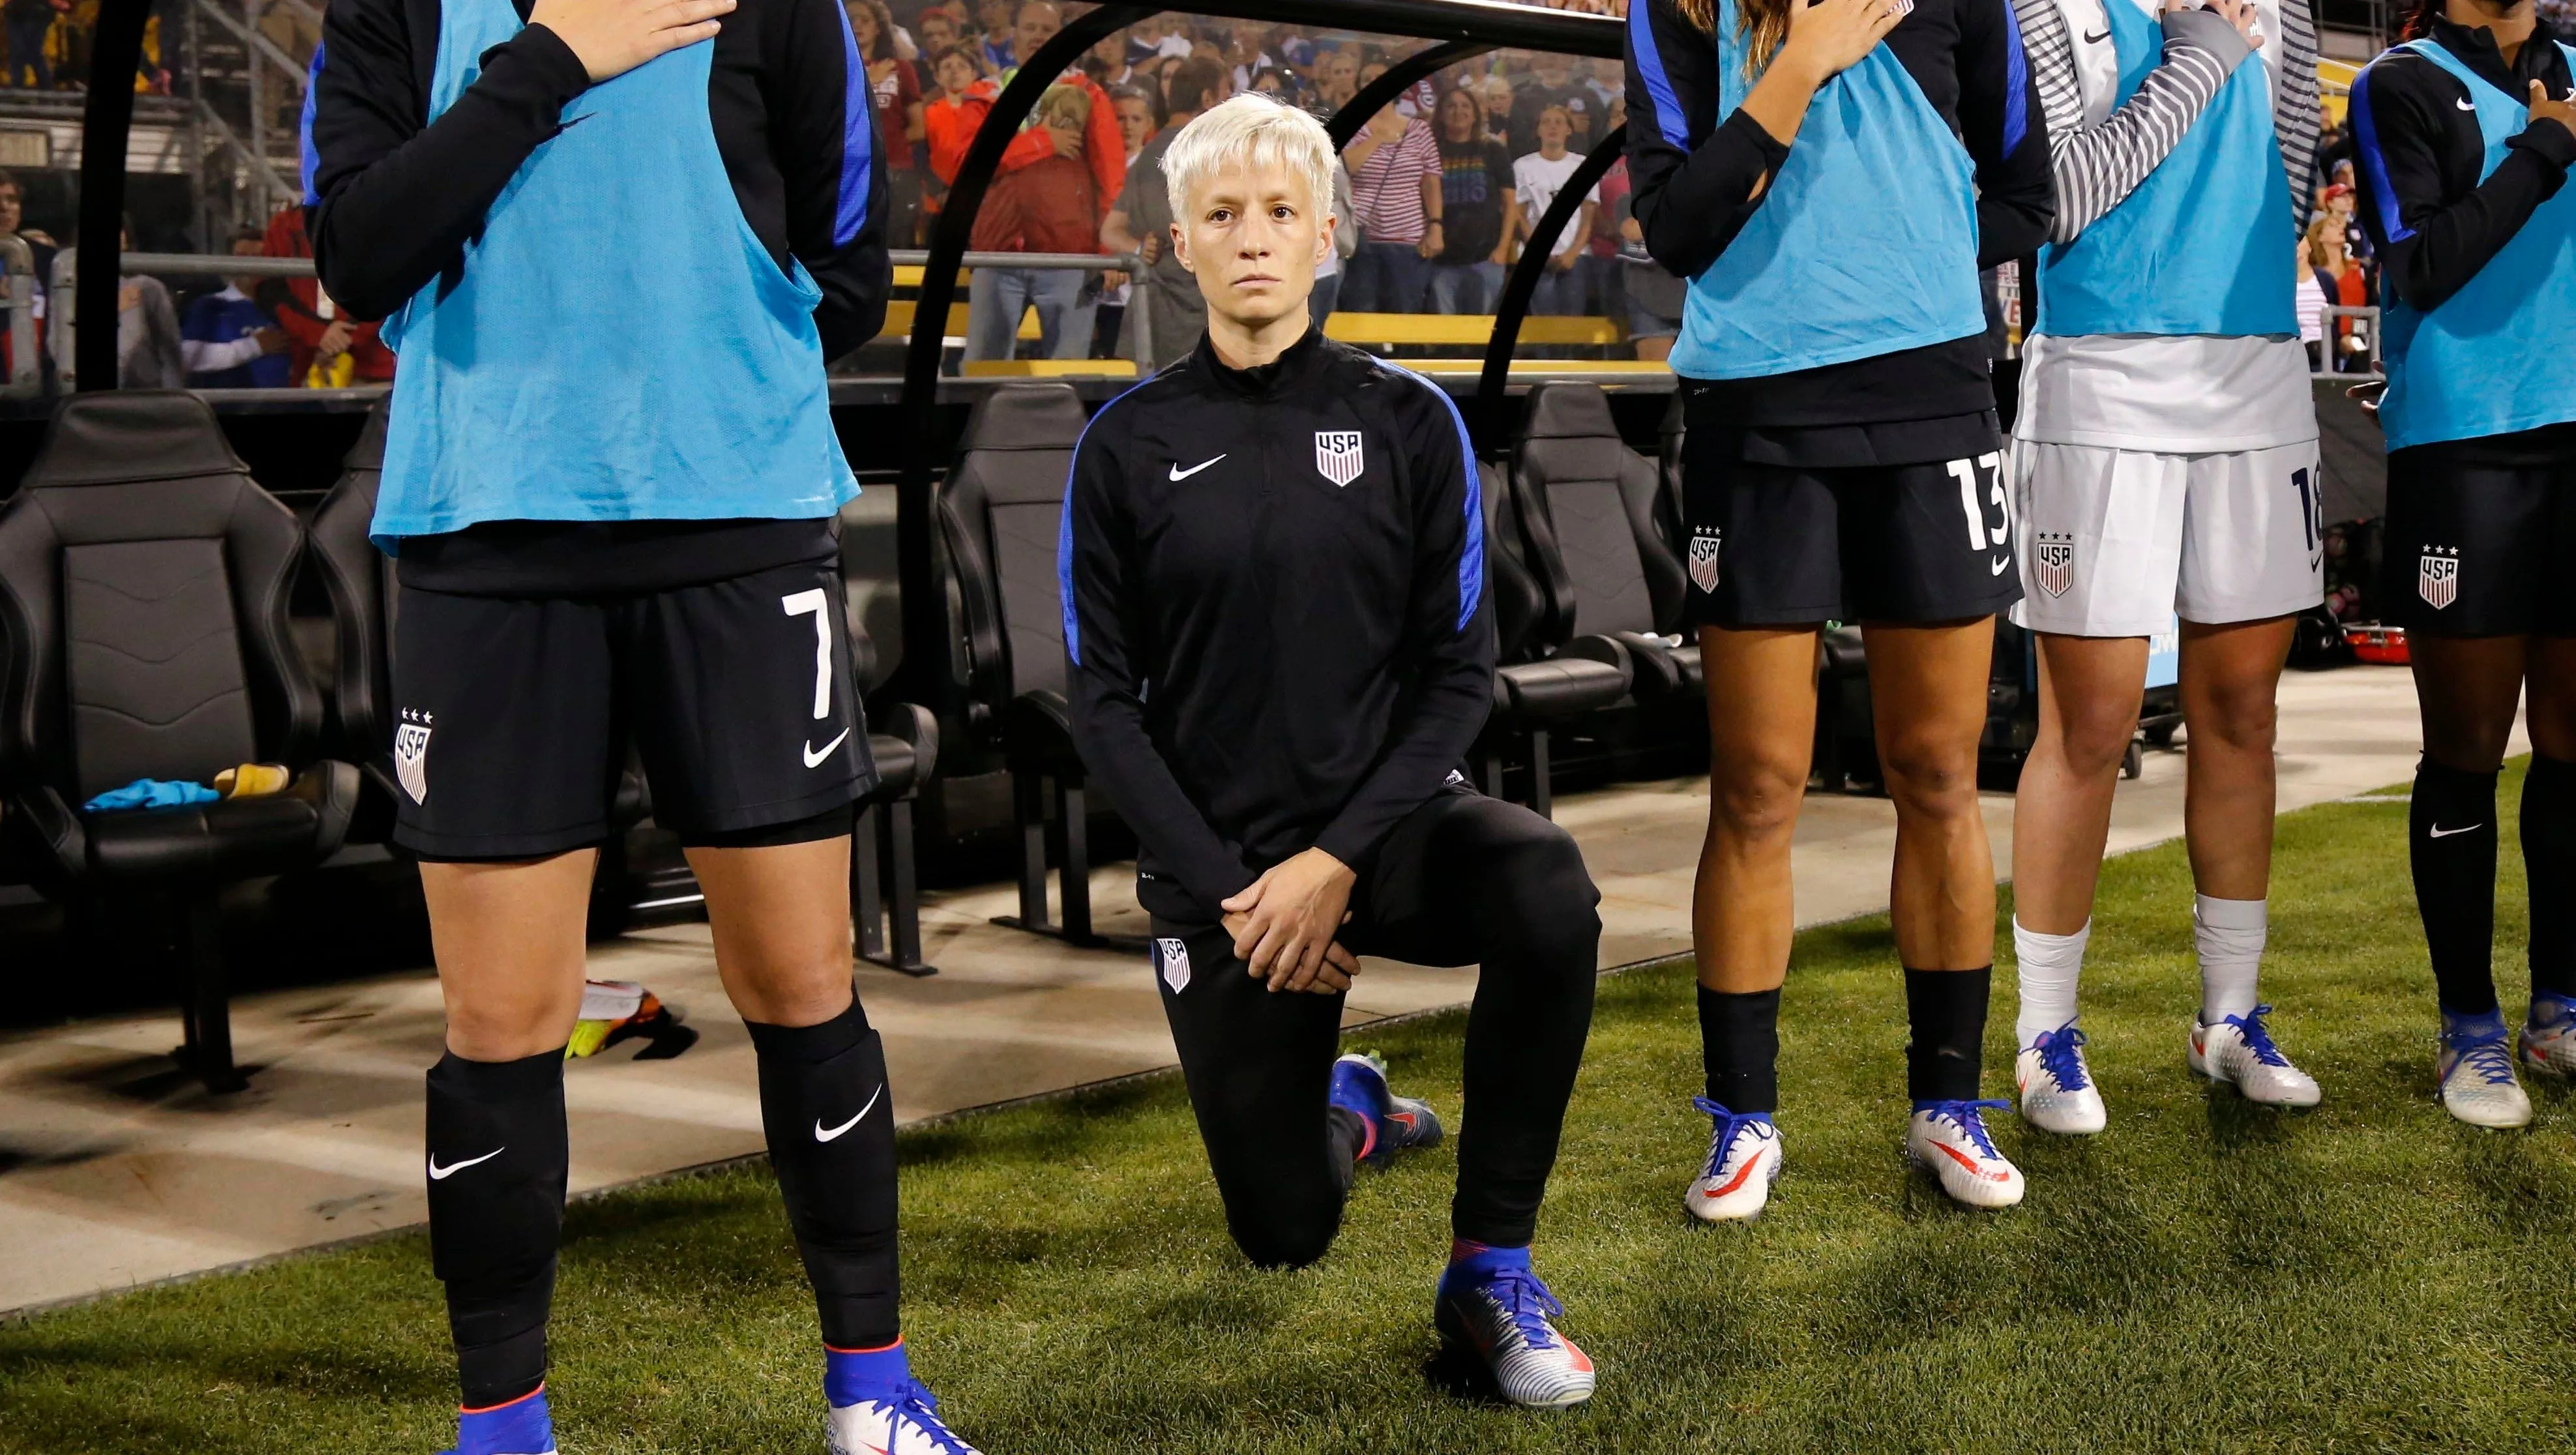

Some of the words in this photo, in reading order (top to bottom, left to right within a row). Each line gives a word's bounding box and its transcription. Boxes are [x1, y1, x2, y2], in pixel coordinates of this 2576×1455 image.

[1318, 434, 1359, 454] USA
[1946, 450, 2009, 551] 13
[1691, 539, 1718, 562] USA
[2040, 546, 2070, 566] USA
[2423, 559, 2455, 580] USA
[782, 587, 833, 720] 7
[398, 727, 426, 760] USA
[1161, 940, 1185, 960] USA
